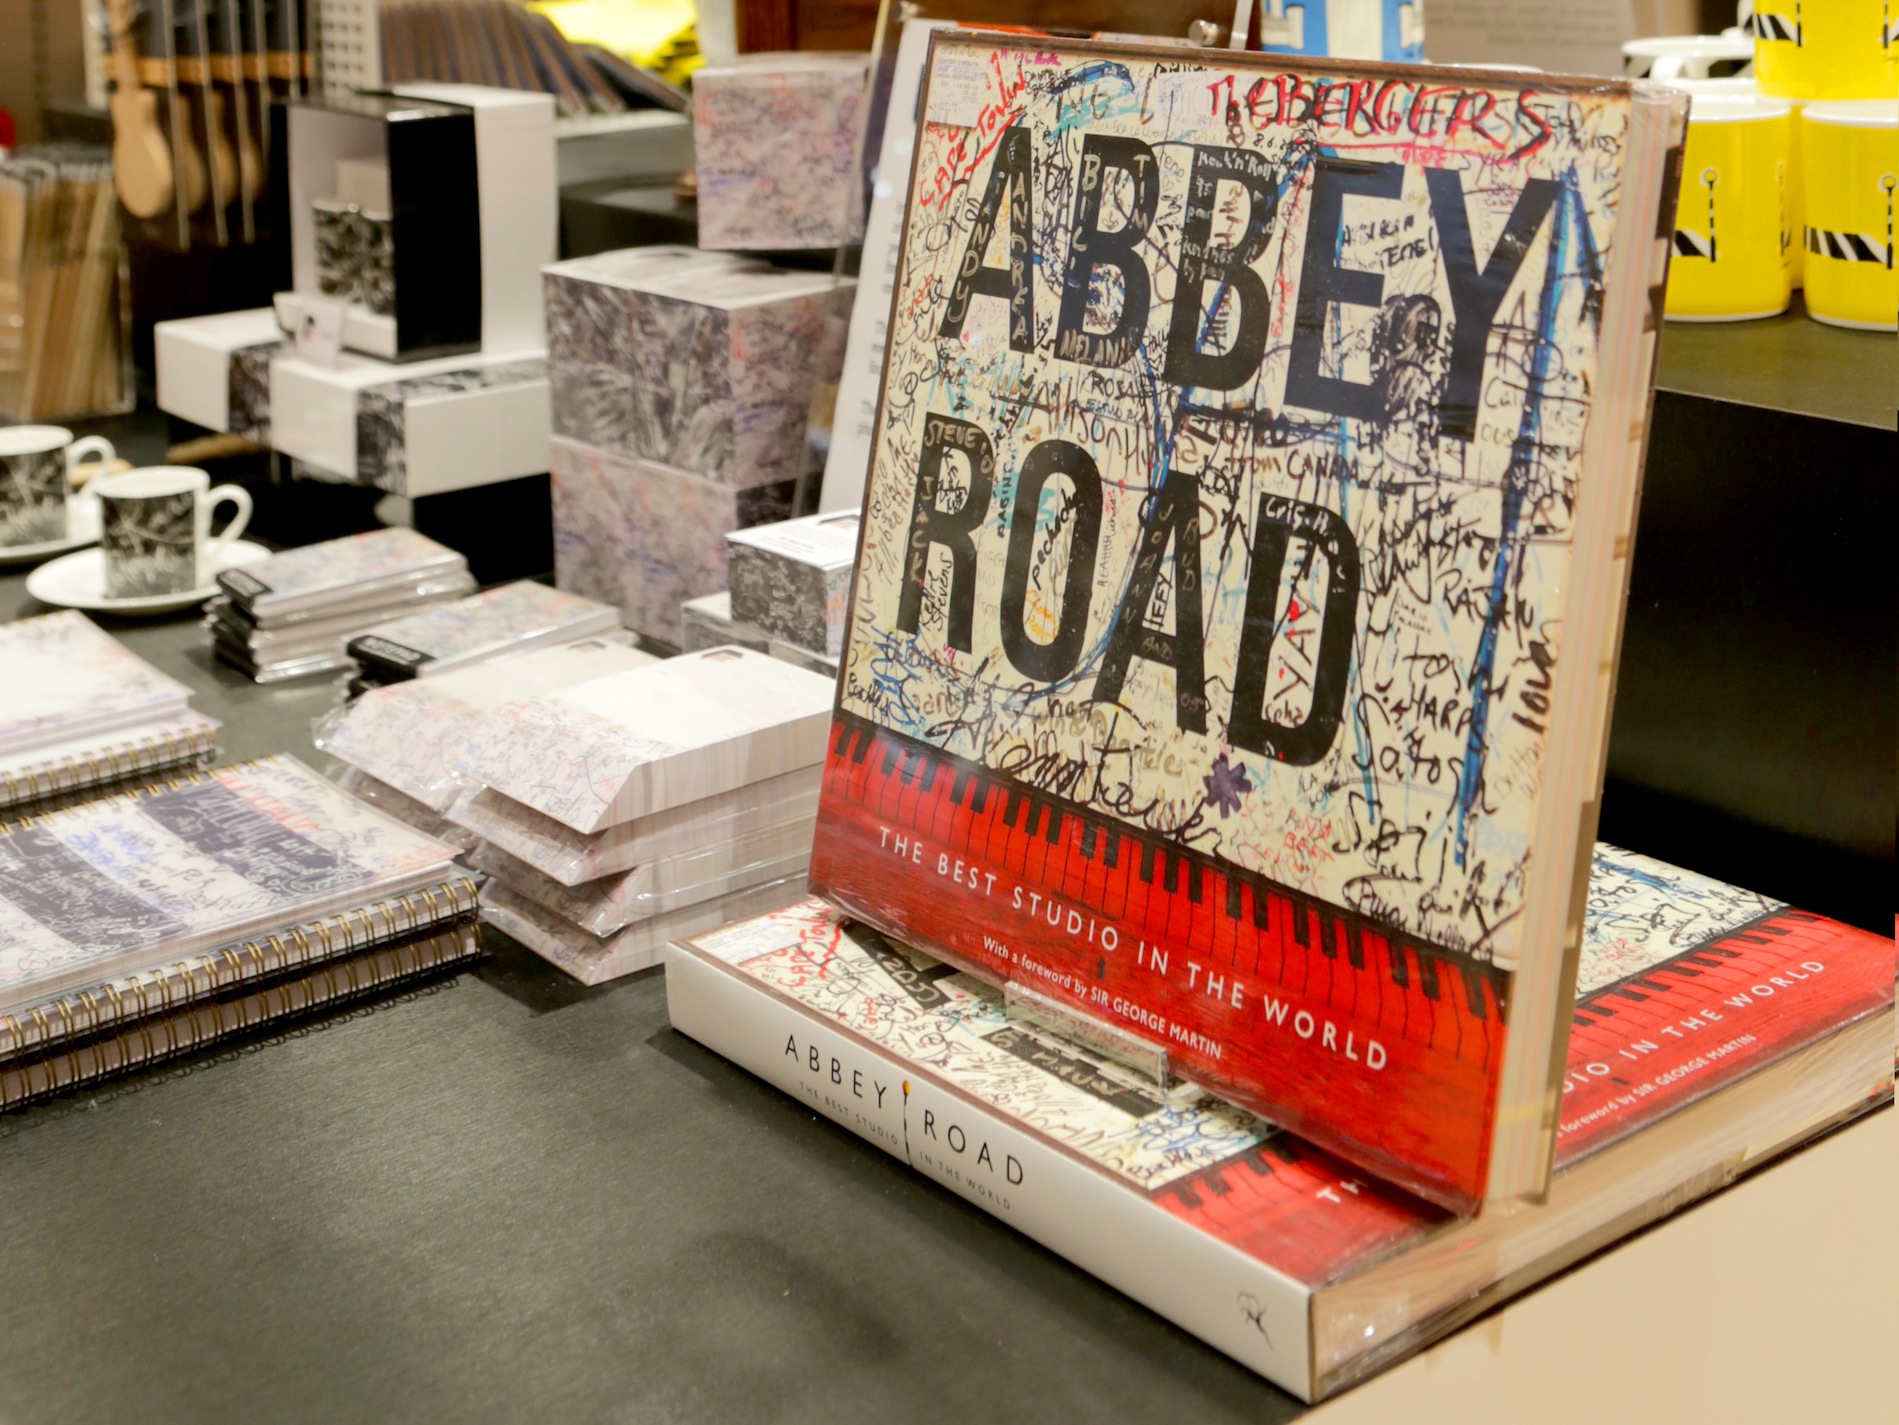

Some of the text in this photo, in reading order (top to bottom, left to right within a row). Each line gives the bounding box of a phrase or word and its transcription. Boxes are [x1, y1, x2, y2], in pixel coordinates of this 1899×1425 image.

[938, 125, 1565, 444] ABBEY
[897, 412, 1361, 767] ROAD
[879, 826, 1387, 1071] THE BEST STUDIO IN THE WORLD
[983, 935, 1222, 1060] With a foreword by SIR GEORGE MARTIN
[1618, 1039, 1660, 1060] IN
[1661, 1009, 1723, 1038] THE
[1724, 960, 1825, 1010] WORLD
[785, 1034, 1024, 1186] ABBEY ROAD
[799, 1081, 1011, 1210] THE BEST STUDIO IN THE WORLD
[1560, 1034, 1757, 1134] foreword by SIR GEORGE MARTIN
